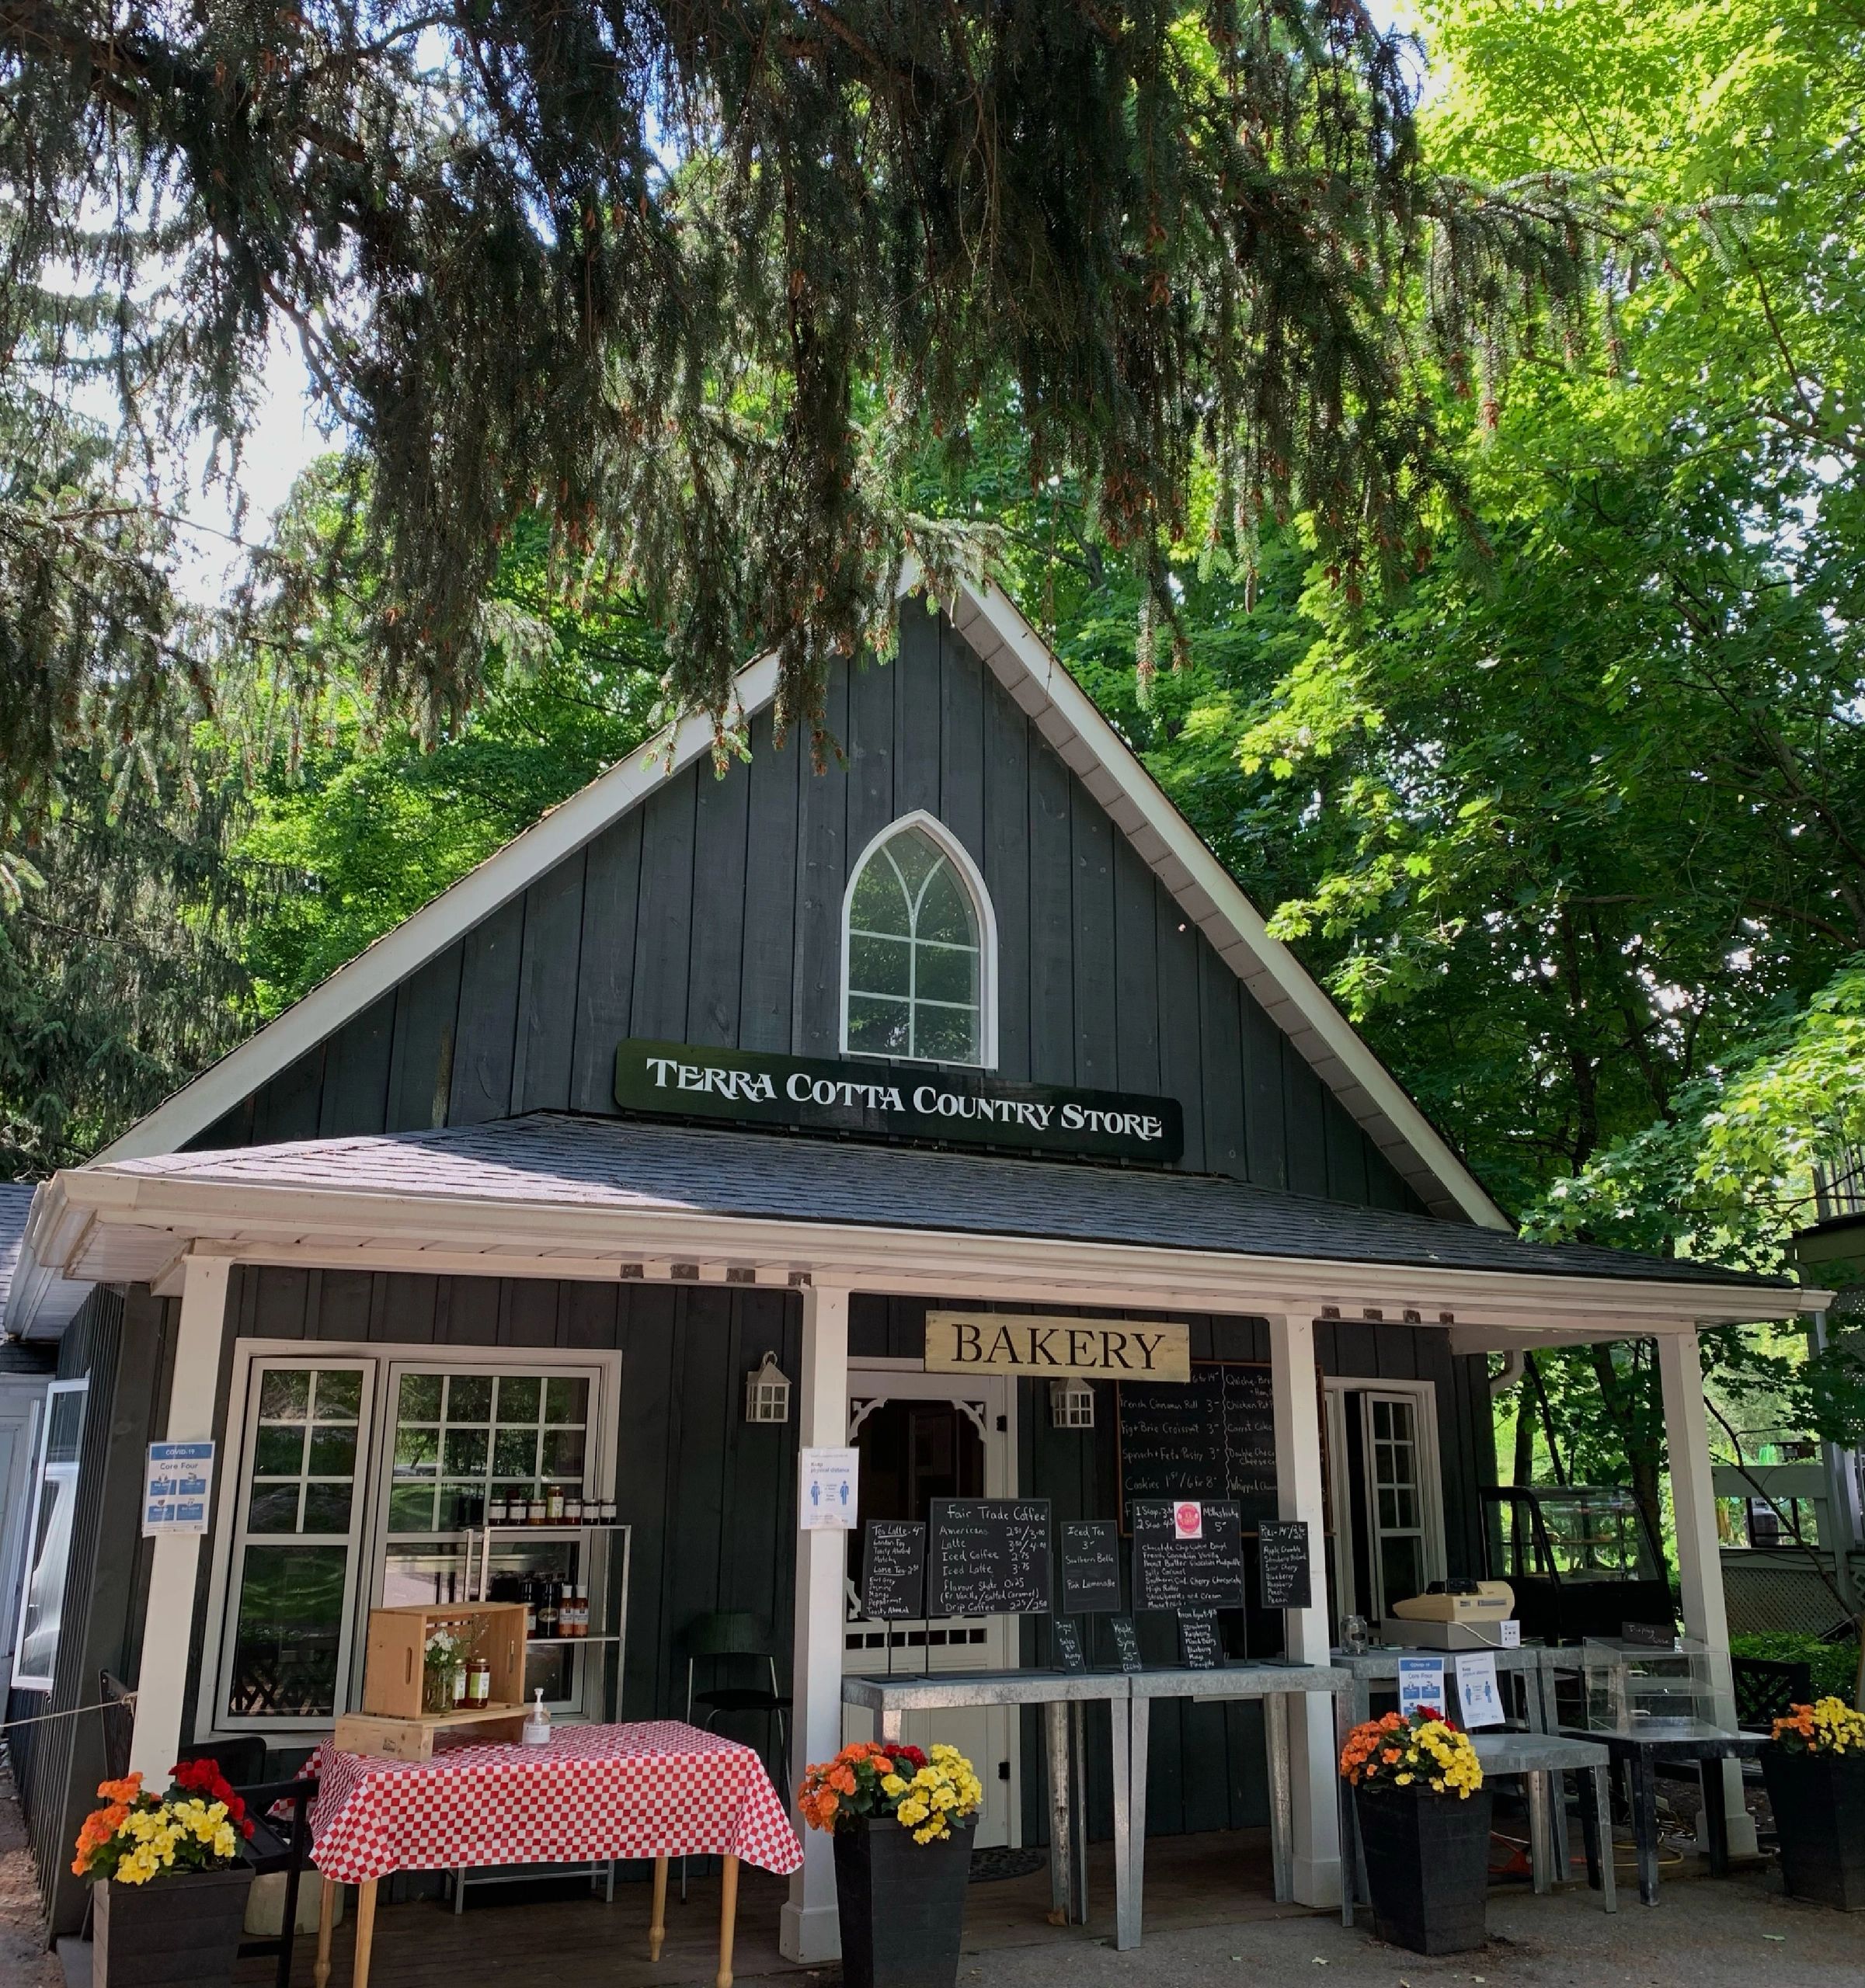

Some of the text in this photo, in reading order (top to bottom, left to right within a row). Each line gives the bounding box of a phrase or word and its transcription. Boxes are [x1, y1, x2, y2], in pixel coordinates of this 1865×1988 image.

[646, 1058, 1163, 1141] TERRA COTTA COUNTRY STORE
[951, 1322, 1166, 1371] BAKERY
[1227, 1420, 1251, 1432] Carrot
[1125, 1475, 1160, 1490] Cookies
[947, 1503, 1046, 1521] Fair Trade Coffee
[872, 1524, 886, 1536] Tea
[887, 1524, 907, 1536] Latte
[939, 1524, 989, 1536] Americano
[1067, 1525, 1105, 1538] Iced Tea
[941, 1538, 966, 1550] Latte
[942, 1549, 967, 1562] Iced
[969, 1548, 1000, 1560] Coffee
[1065, 1555, 1096, 1565] Southern
[873, 1566, 892, 1574] Loose
[942, 1565, 965, 1576] Iced
[969, 1563, 993, 1574] Latte
[1066, 1578, 1115, 1590] Pink Lemonade
[945, 1602, 995, 1613] Drip Coffee
